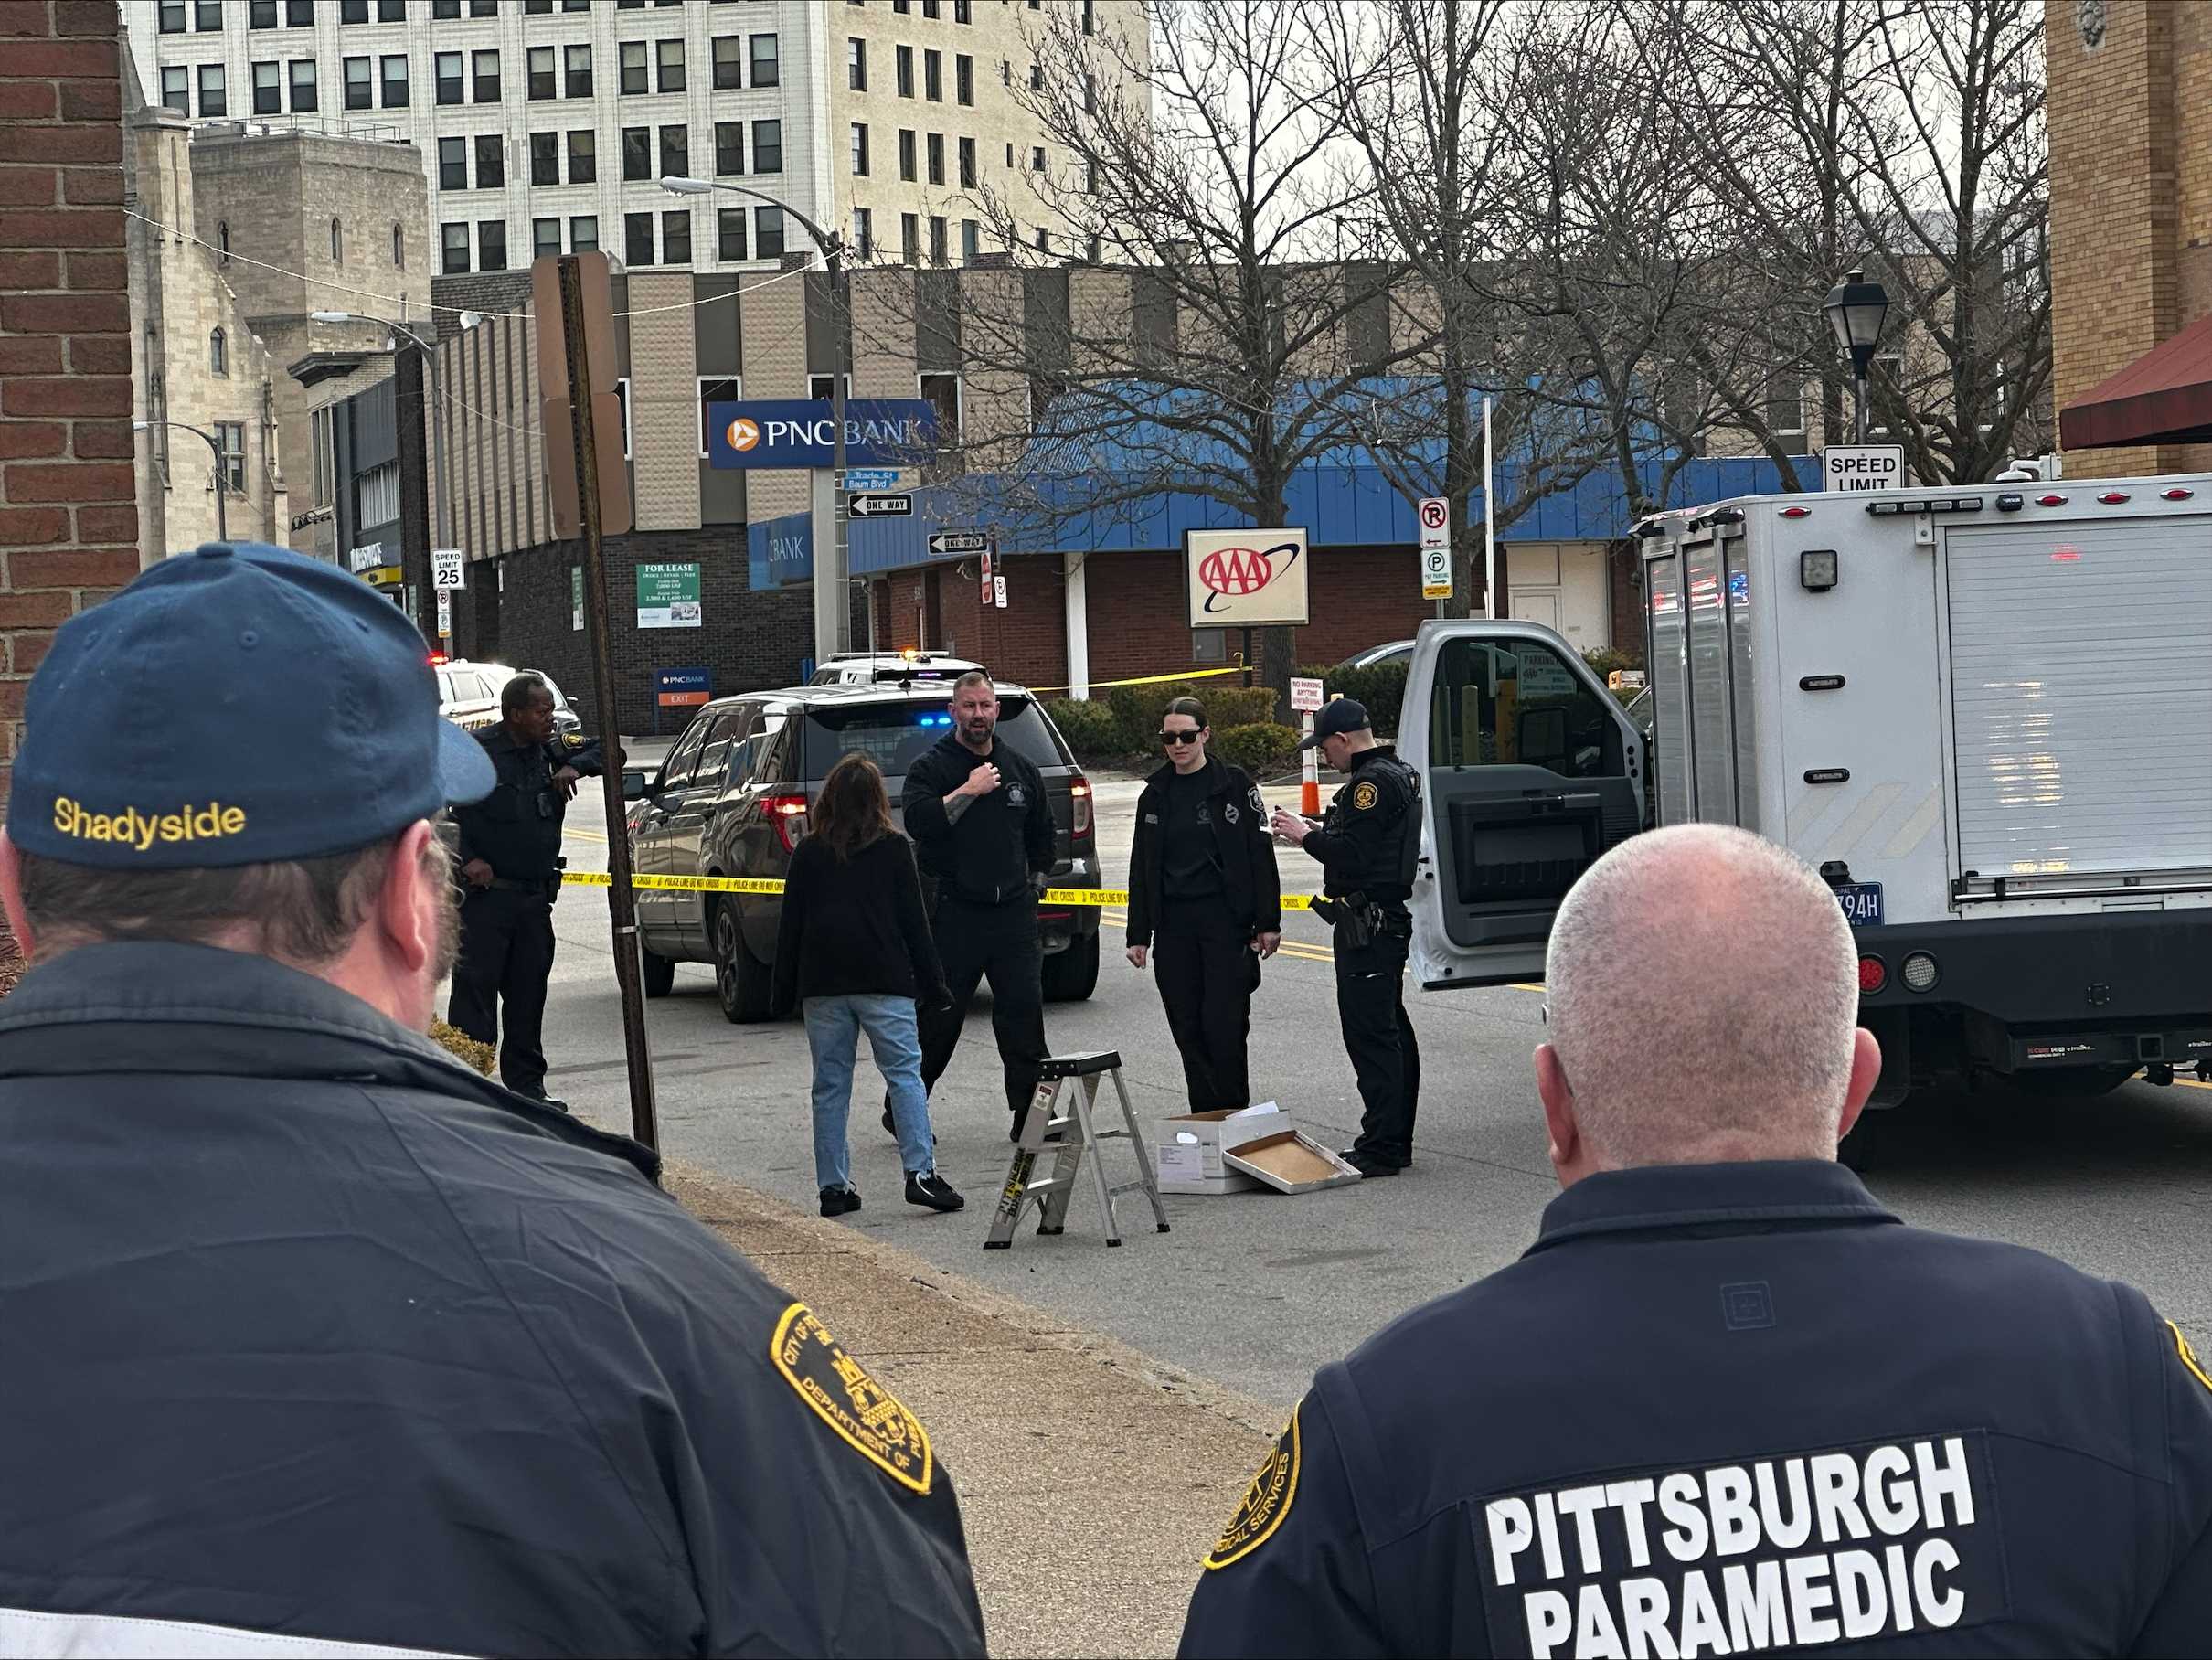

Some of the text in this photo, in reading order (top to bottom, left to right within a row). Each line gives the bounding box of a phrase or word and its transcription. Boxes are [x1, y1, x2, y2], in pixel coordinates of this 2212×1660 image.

[764, 420, 922, 446] PNC BANK
[1830, 458, 1897, 474] SPEED
[848, 479, 887, 488] Baum Blvd
[1839, 478, 1889, 492] LIMIT
[867, 500, 905, 510] ONE WAY
[944, 537, 981, 548] ONE WAY
[434, 553, 461, 561] SPEED
[644, 563, 694, 573] FOR LEASE
[1204, 548, 1269, 595] AAA
[438, 569, 460, 585] 25
[1301, 681, 1322, 689] PARKING
[671, 695, 688, 703] EXIT
[53, 796, 247, 852] Shadyside
[665, 878, 680, 887] POLICE
[680, 878, 690, 887] LINE
[696, 878, 706, 888] NOT
[706, 878, 720, 889] CROSS
[733, 879, 748, 889] POLICE
[749, 880, 759, 890] LINE
[765, 881, 774, 890] NOT
[1059, 891, 1076, 902] CROSS
[1090, 892, 1105, 902] POLICE
[1105, 892, 1115, 902] LINE
[783, 1321, 809, 1366] CITY OF
[802, 1377, 893, 1457] DEPARTMENT
[894, 1451, 911, 1470] OF
[1250, 1452, 1290, 1532] SERVICES
[1484, 1437, 1976, 1587] PITTSBURGH
[1523, 1538, 1965, 1660] PARAMEDIC
